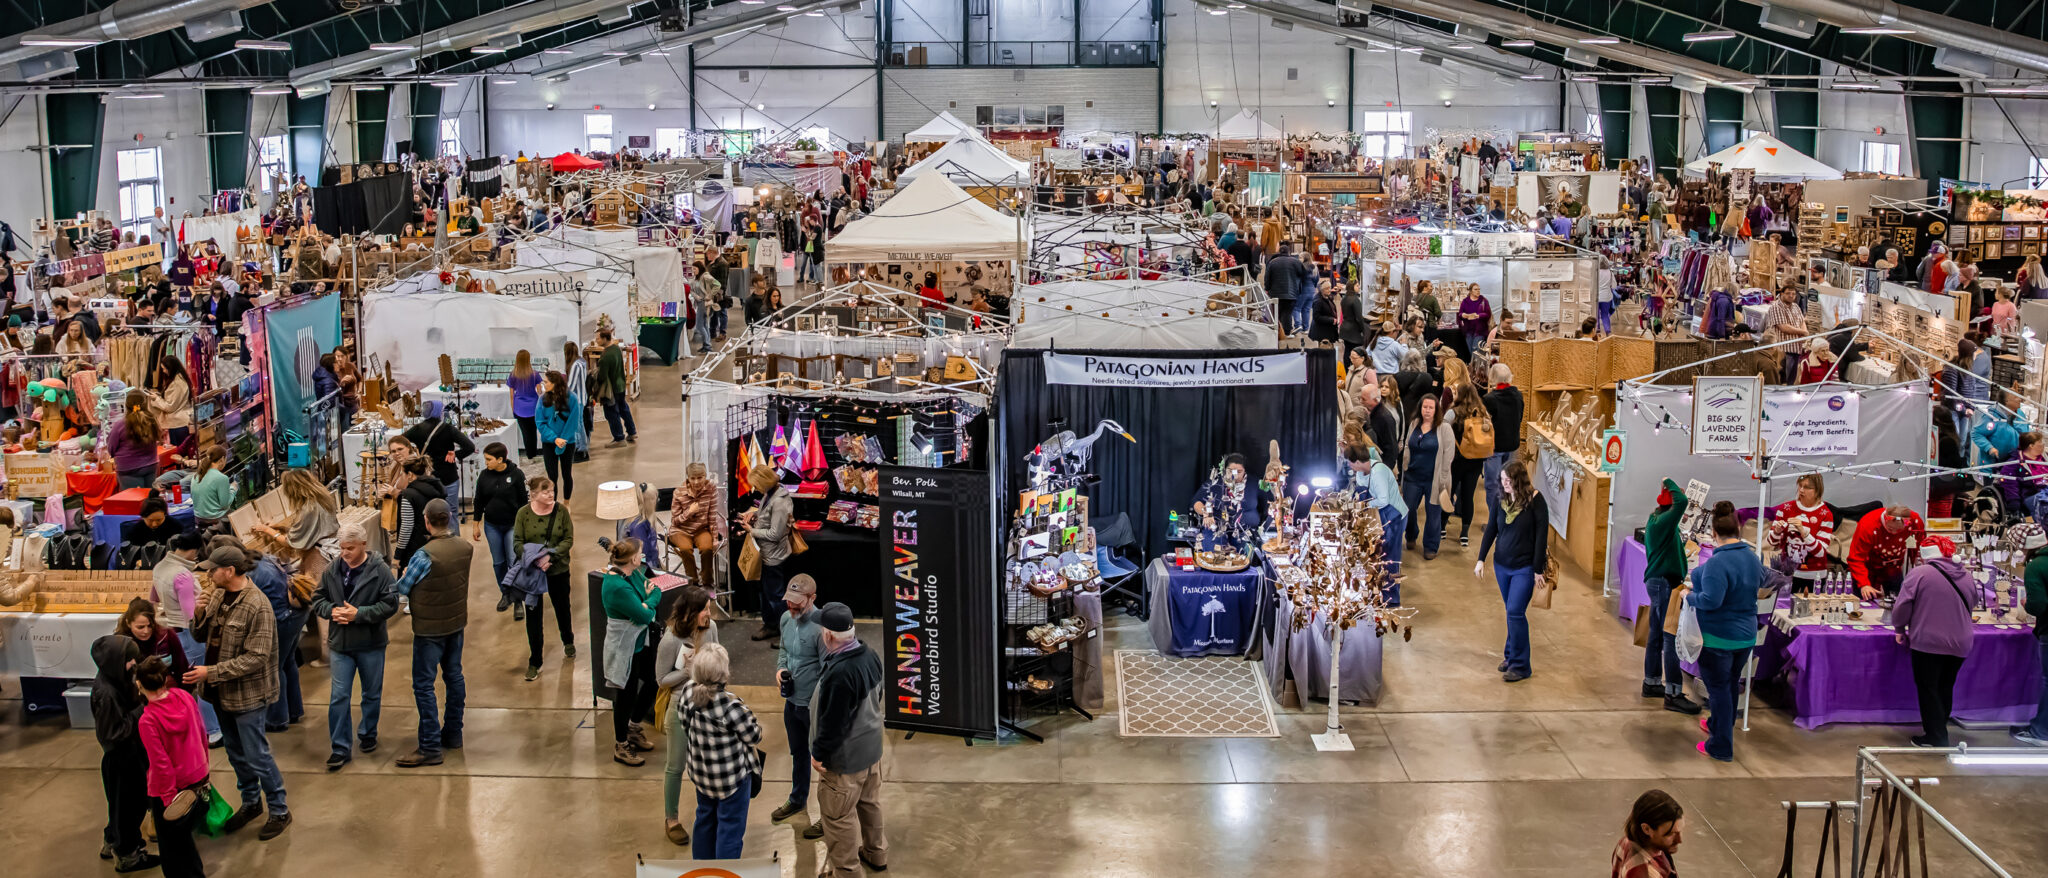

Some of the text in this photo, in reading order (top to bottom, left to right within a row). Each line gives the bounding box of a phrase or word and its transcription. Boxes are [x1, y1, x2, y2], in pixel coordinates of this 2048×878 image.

[887, 252, 953, 260] METALLIC WEAVER
[504, 276, 584, 297] gratitude
[1092, 377, 1115, 385] Needle
[1136, 378, 1171, 387] sculptures,
[1172, 379, 1196, 387] jewelry
[1212, 377, 1244, 385] functional
[1707, 414, 1742, 423] BIG SKY
[1807, 419, 1848, 428] Ingredients,
[1701, 424, 1746, 433] LAVENDER
[1788, 428, 1855, 438] Long Term Benefits
[1708, 434, 1738, 442] FARMS
[892, 476, 938, 488] Bev. Polk
[891, 490, 914, 499] Wilsall,
[893, 509, 922, 716] HANDWEAVER
[924, 574, 940, 716] Weaverbird Studio
